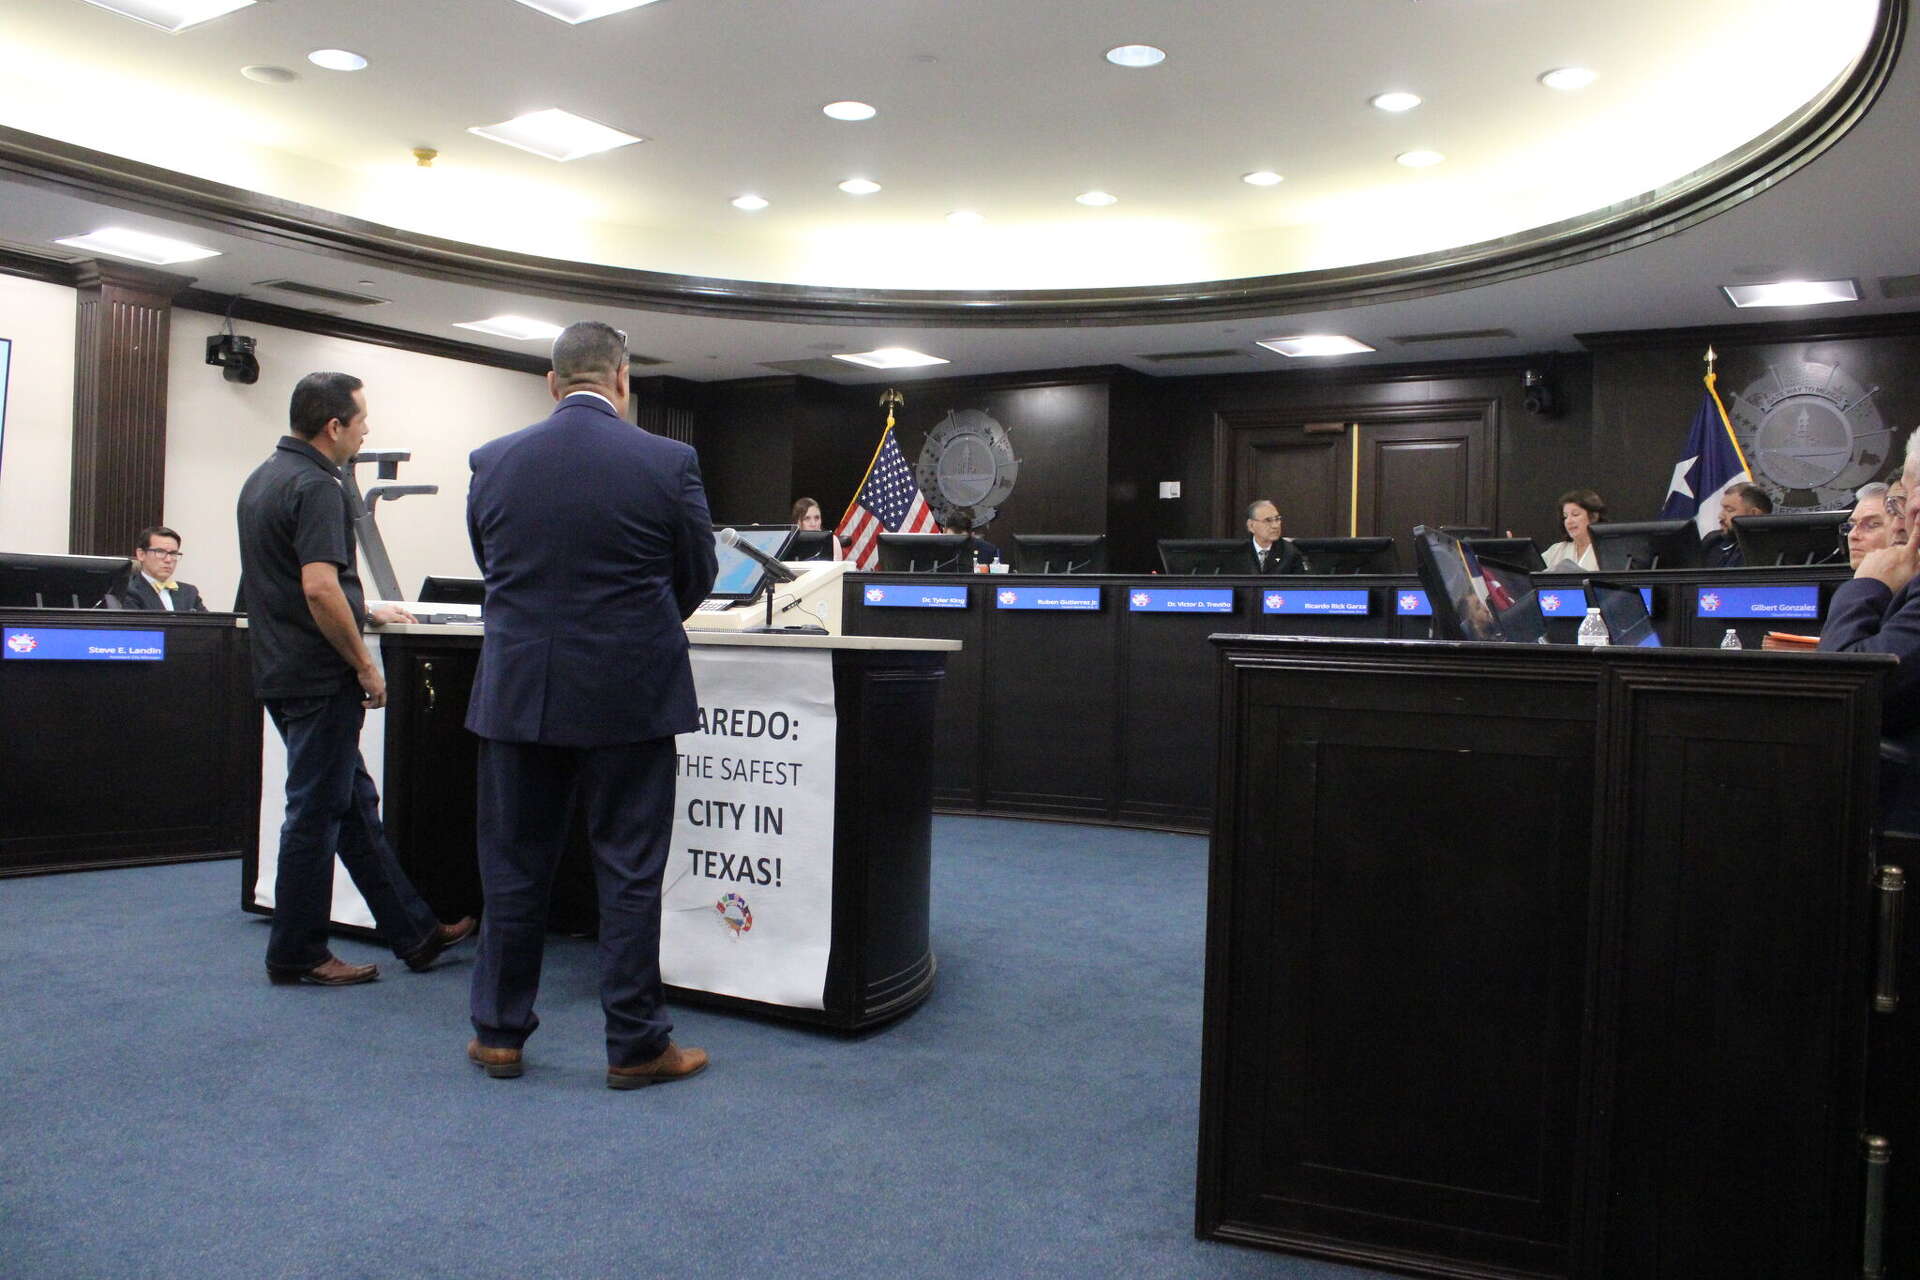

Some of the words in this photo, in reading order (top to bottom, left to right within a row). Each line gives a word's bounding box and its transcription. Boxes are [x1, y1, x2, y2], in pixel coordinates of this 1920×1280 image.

[1751, 603, 1778, 611] Gilbert
[1779, 603, 1816, 611] Gonzalez
[88, 646, 116, 654] Steve
[129, 647, 161, 655] Landin
[696, 706, 800, 741] AREDO:
[675, 753, 713, 779] THE
[721, 757, 803, 786] SAFEST
[688, 799, 746, 831] CITY
[754, 805, 783, 835] IN
[687, 849, 782, 887] TEXAS!
